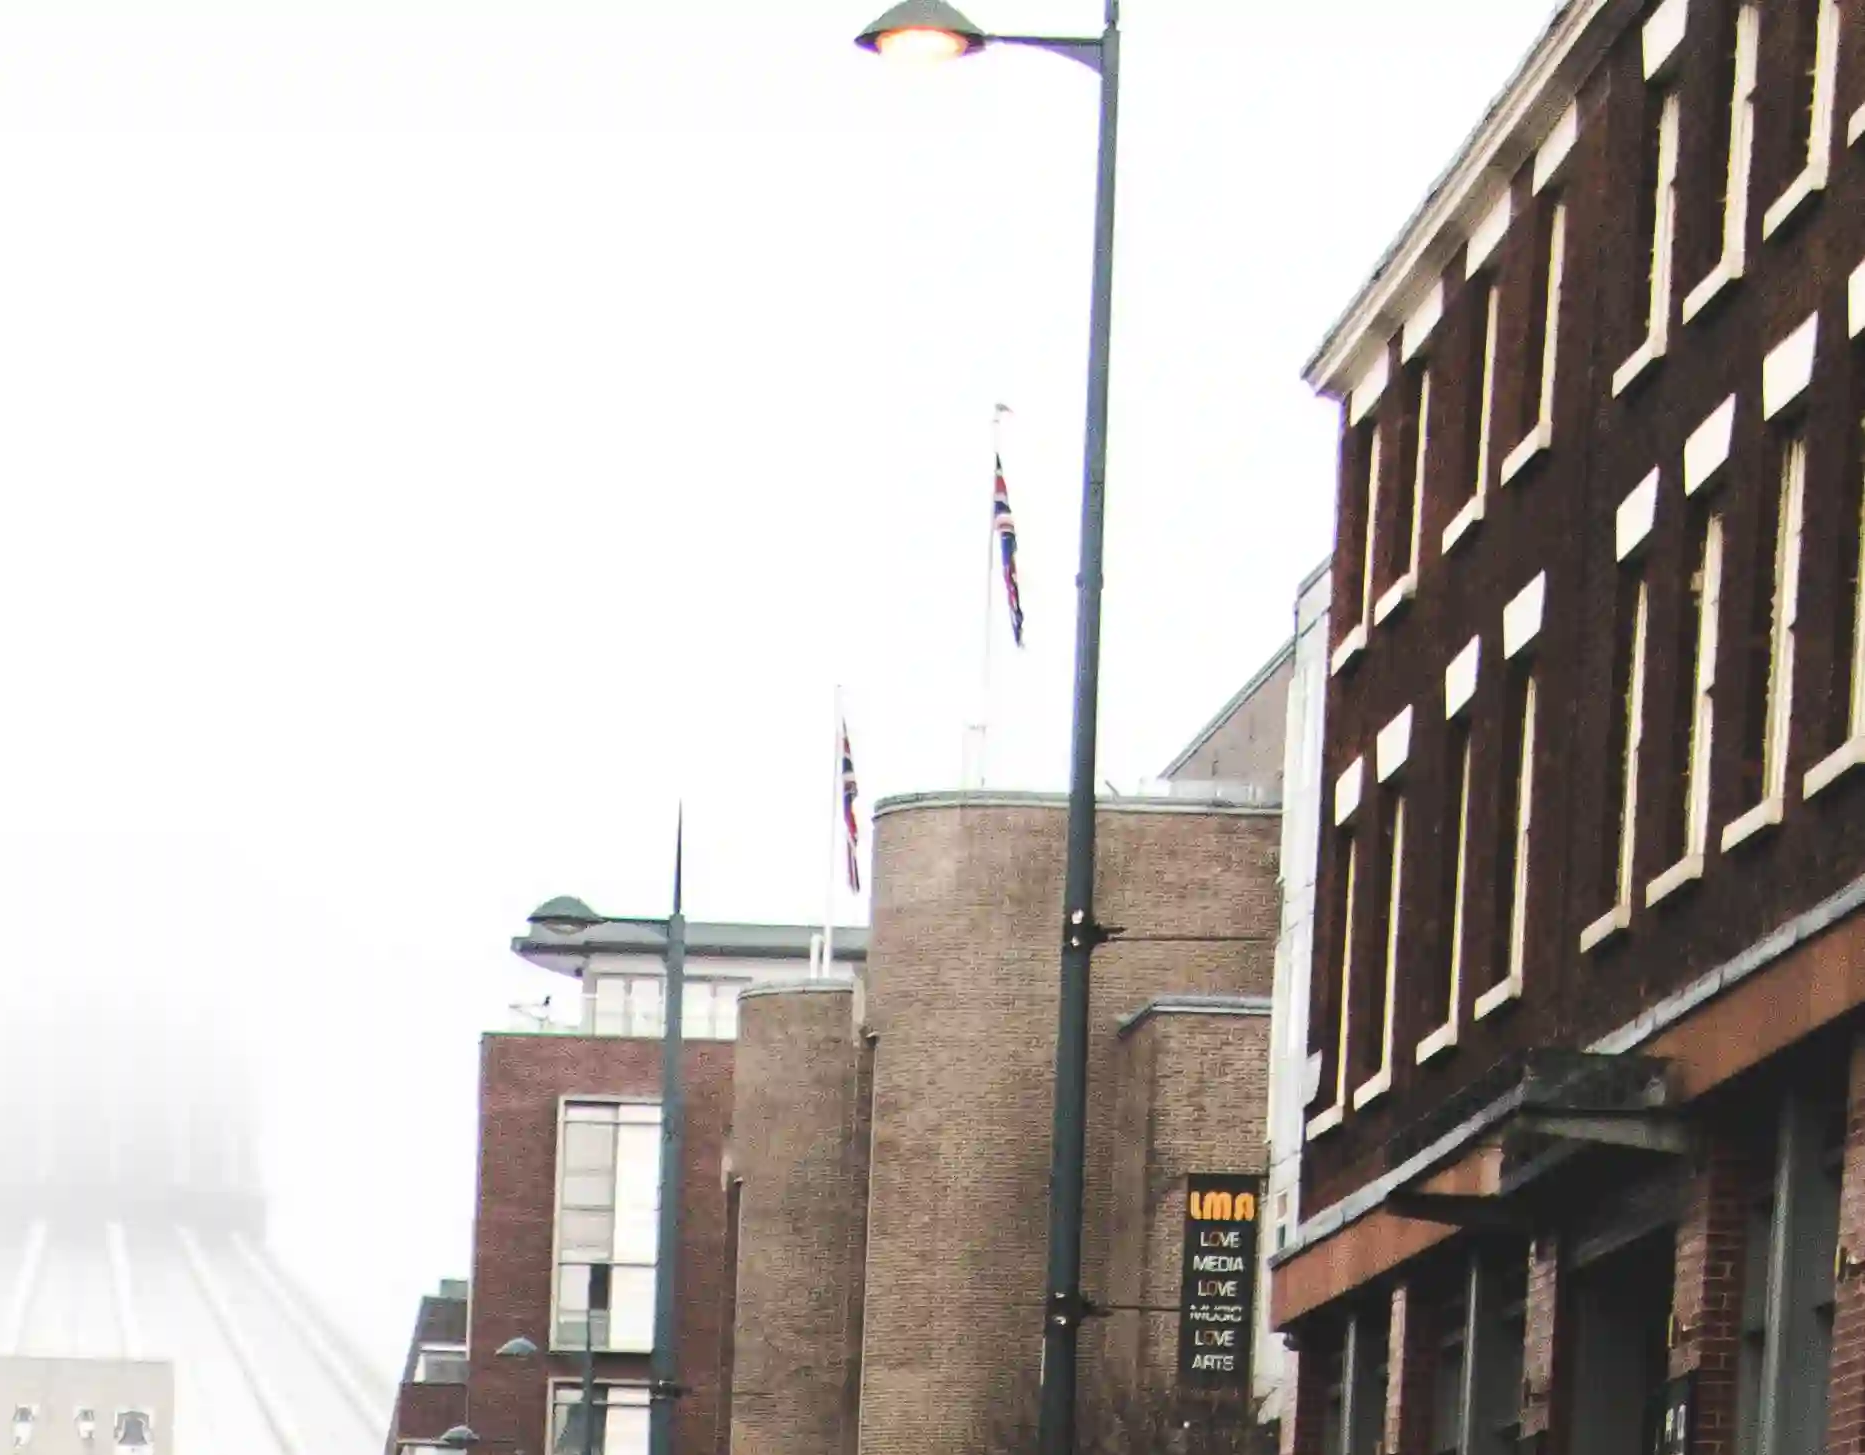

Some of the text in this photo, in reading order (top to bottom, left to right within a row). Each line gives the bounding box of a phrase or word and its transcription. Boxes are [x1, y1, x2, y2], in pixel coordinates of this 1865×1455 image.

[1190, 1190, 1255, 1222] LMA
[1200, 1231, 1241, 1248] LOVE
[1193, 1255, 1244, 1272] MEDIA
[1197, 1280, 1238, 1297] LOVE
[1189, 1304, 1243, 1322] MUSIC
[1194, 1330, 1235, 1346] LOVE
[1191, 1354, 1234, 1371] ARTS
